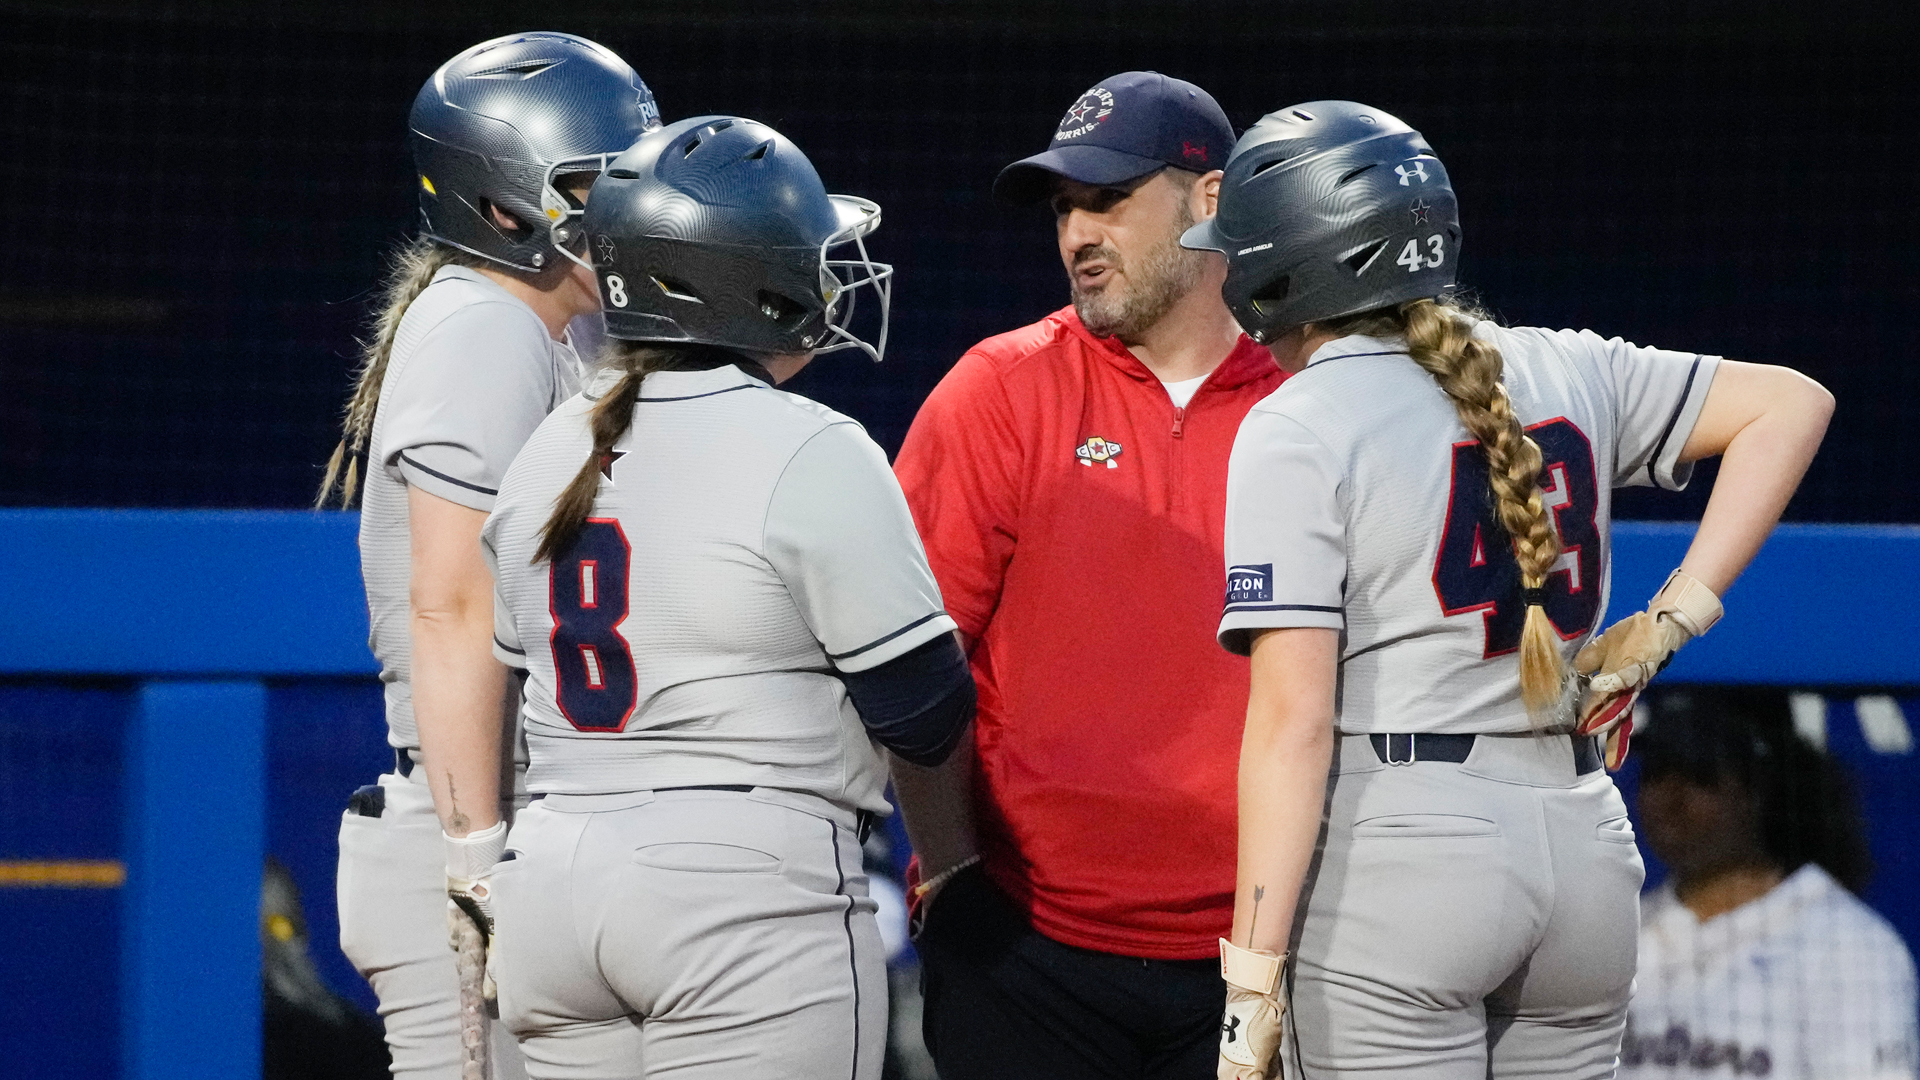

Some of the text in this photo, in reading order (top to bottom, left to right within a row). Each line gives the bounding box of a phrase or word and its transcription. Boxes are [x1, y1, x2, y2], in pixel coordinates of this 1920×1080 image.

[1396, 234, 1445, 273] 43
[606, 274, 629, 308] 8
[1431, 415, 1601, 660] 43
[1229, 577, 1264, 592] IZON
[549, 517, 638, 733] 8
